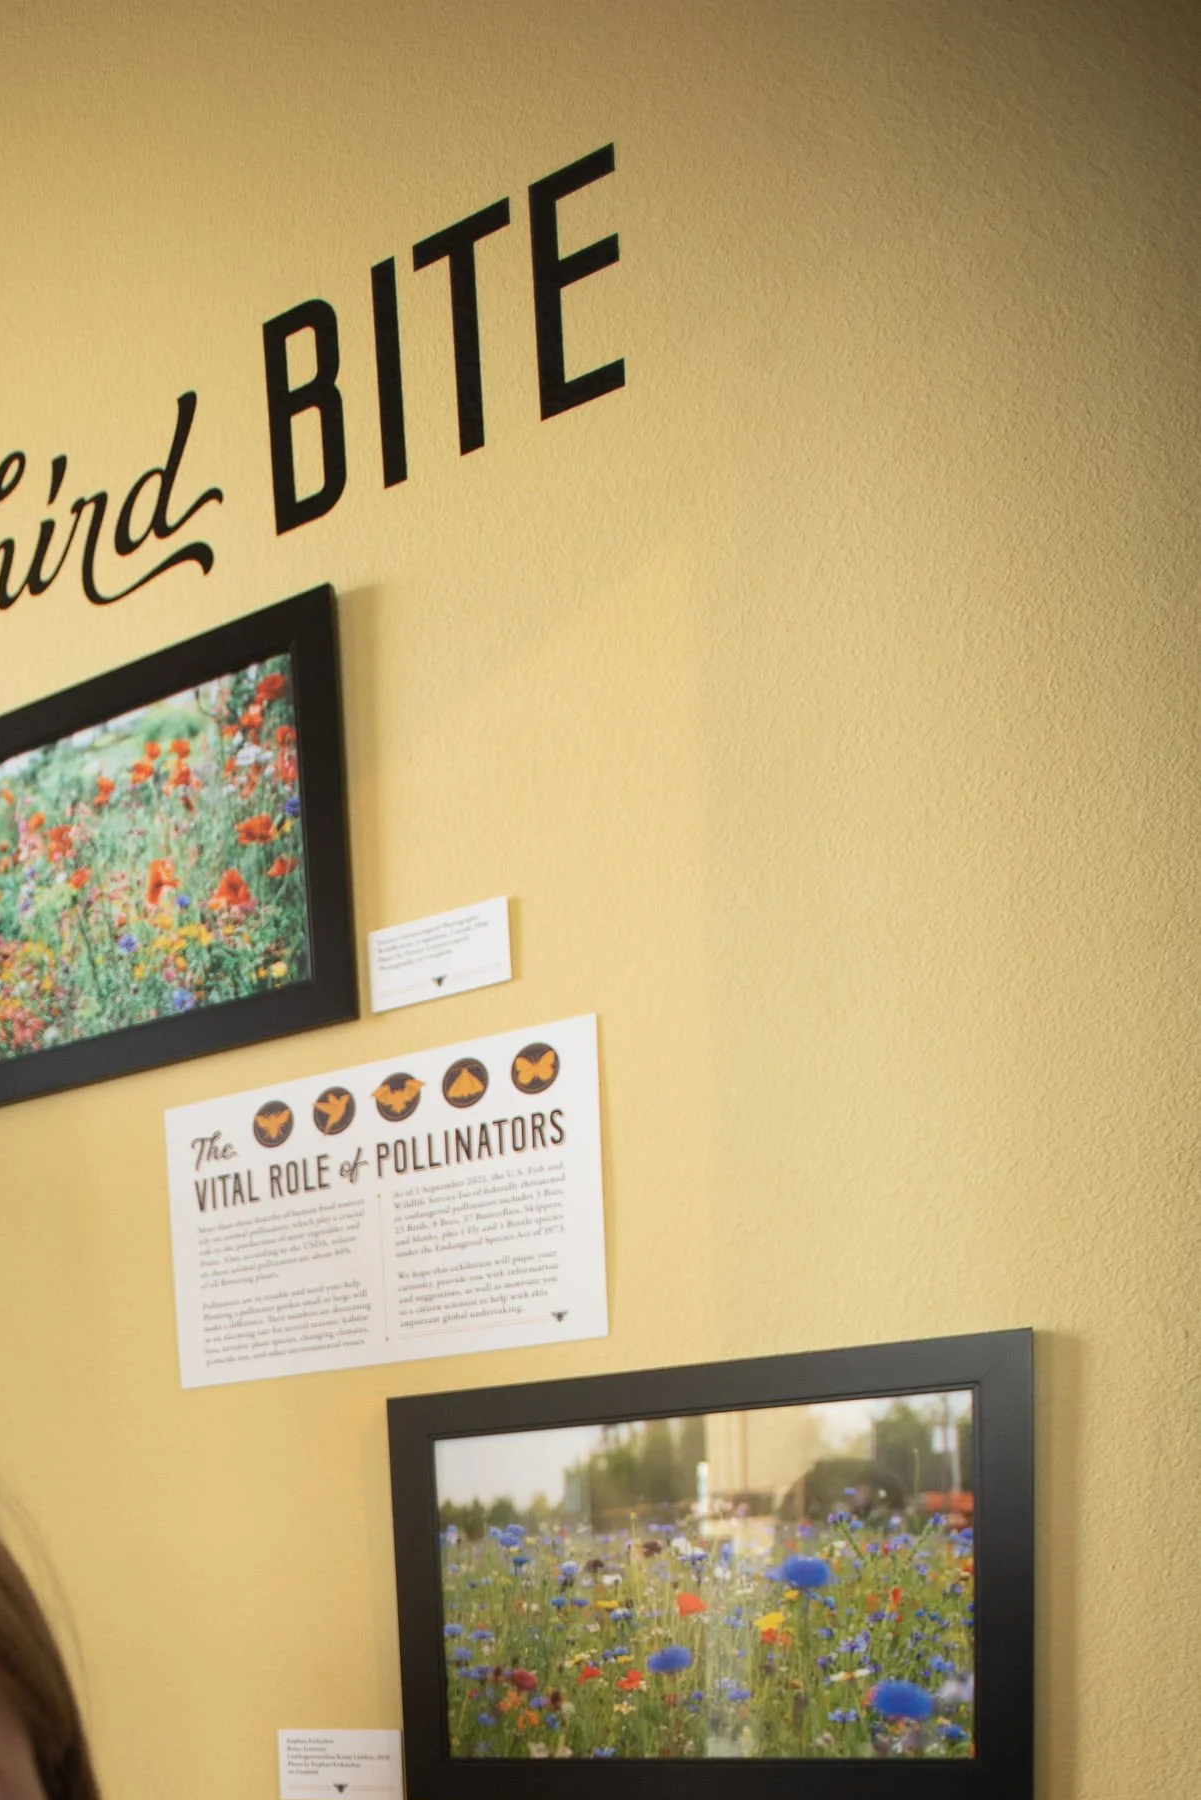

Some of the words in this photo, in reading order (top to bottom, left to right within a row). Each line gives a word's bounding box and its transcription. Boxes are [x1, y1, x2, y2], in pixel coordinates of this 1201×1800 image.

[262, 142, 626, 536] BITE
[191, 1130, 236, 1170] The
[195, 1166, 260, 1213] VITAL
[270, 1154, 331, 1199] ROLE
[338, 1147, 368, 1186] of
[376, 1109, 565, 1178] POLLINATORS
